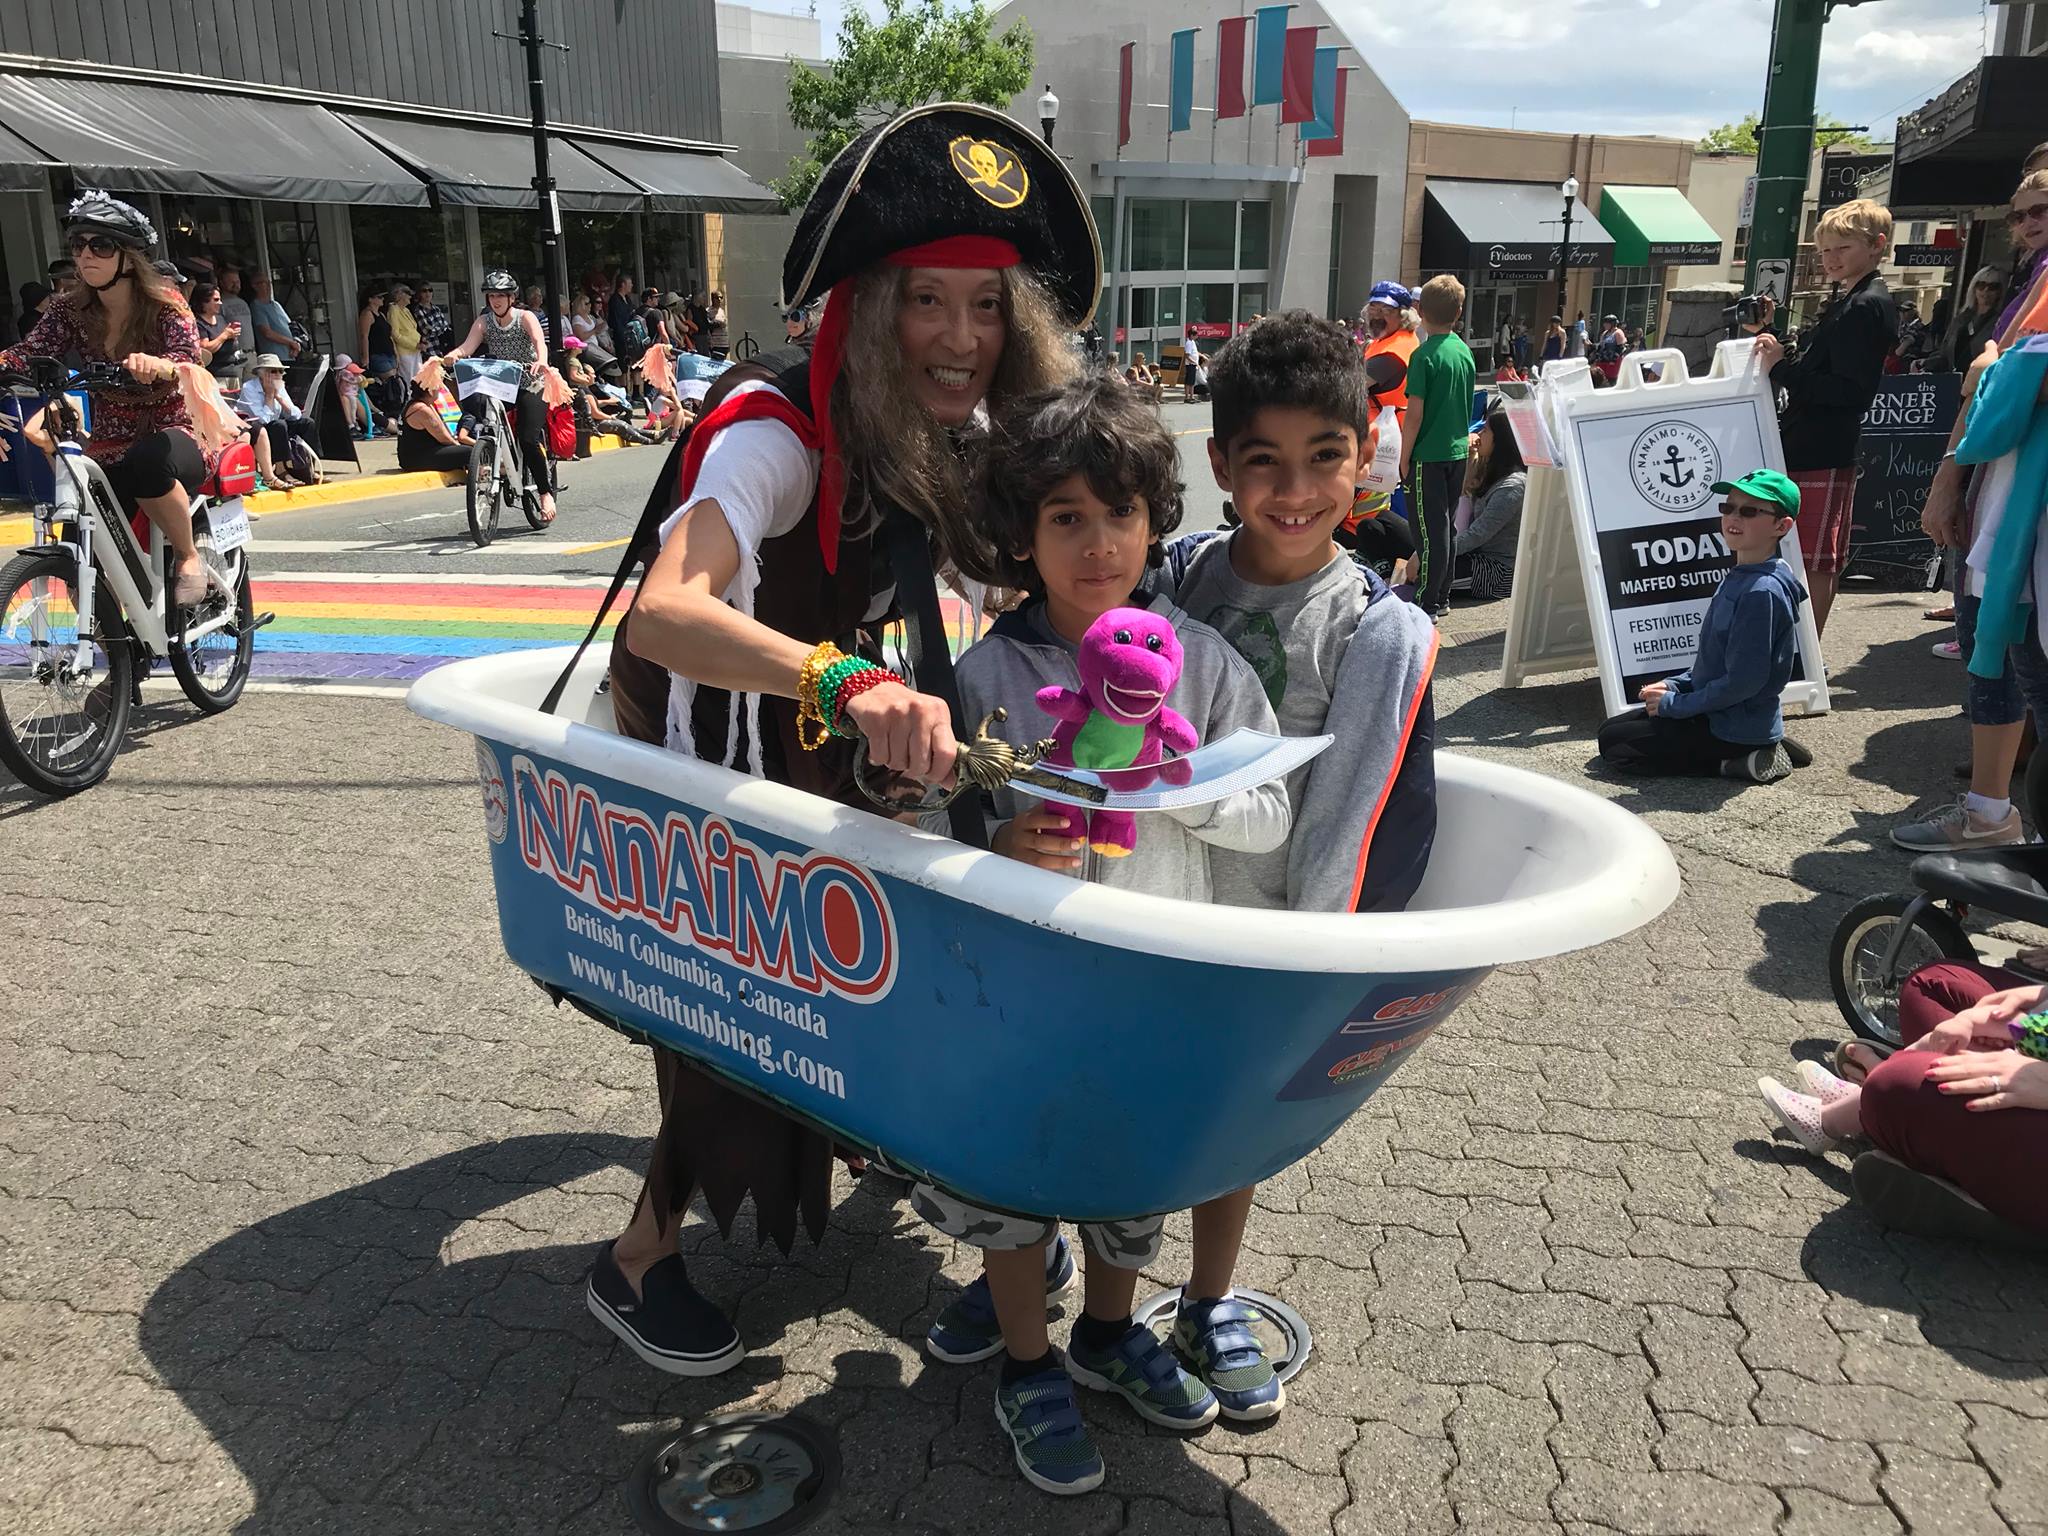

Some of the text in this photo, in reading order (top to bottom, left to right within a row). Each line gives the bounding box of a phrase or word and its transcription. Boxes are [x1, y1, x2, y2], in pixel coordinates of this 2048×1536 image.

[1827, 167, 1881, 186] FOO
[1908, 254, 1942, 265] FOOD
[1918, 381, 1937, 392] the
[1870, 392, 1937, 409] RNER
[1860, 408, 1936, 425] UNGE
[1638, 428, 1713, 505] NANAIMO HERITAGE FESTIVAL
[1893, 519, 1922, 537] NOO
[1631, 532, 1732, 567] TODAY
[1620, 567, 1731, 595] MAFFEO SUTTON
[1629, 612, 1702, 633] FESTIVITIES
[1633, 634, 1696, 654] HERITAGE
[564, 903, 830, 1040] British Columbia, Canada
[568, 951, 847, 1100] www.bathtubbing.com
